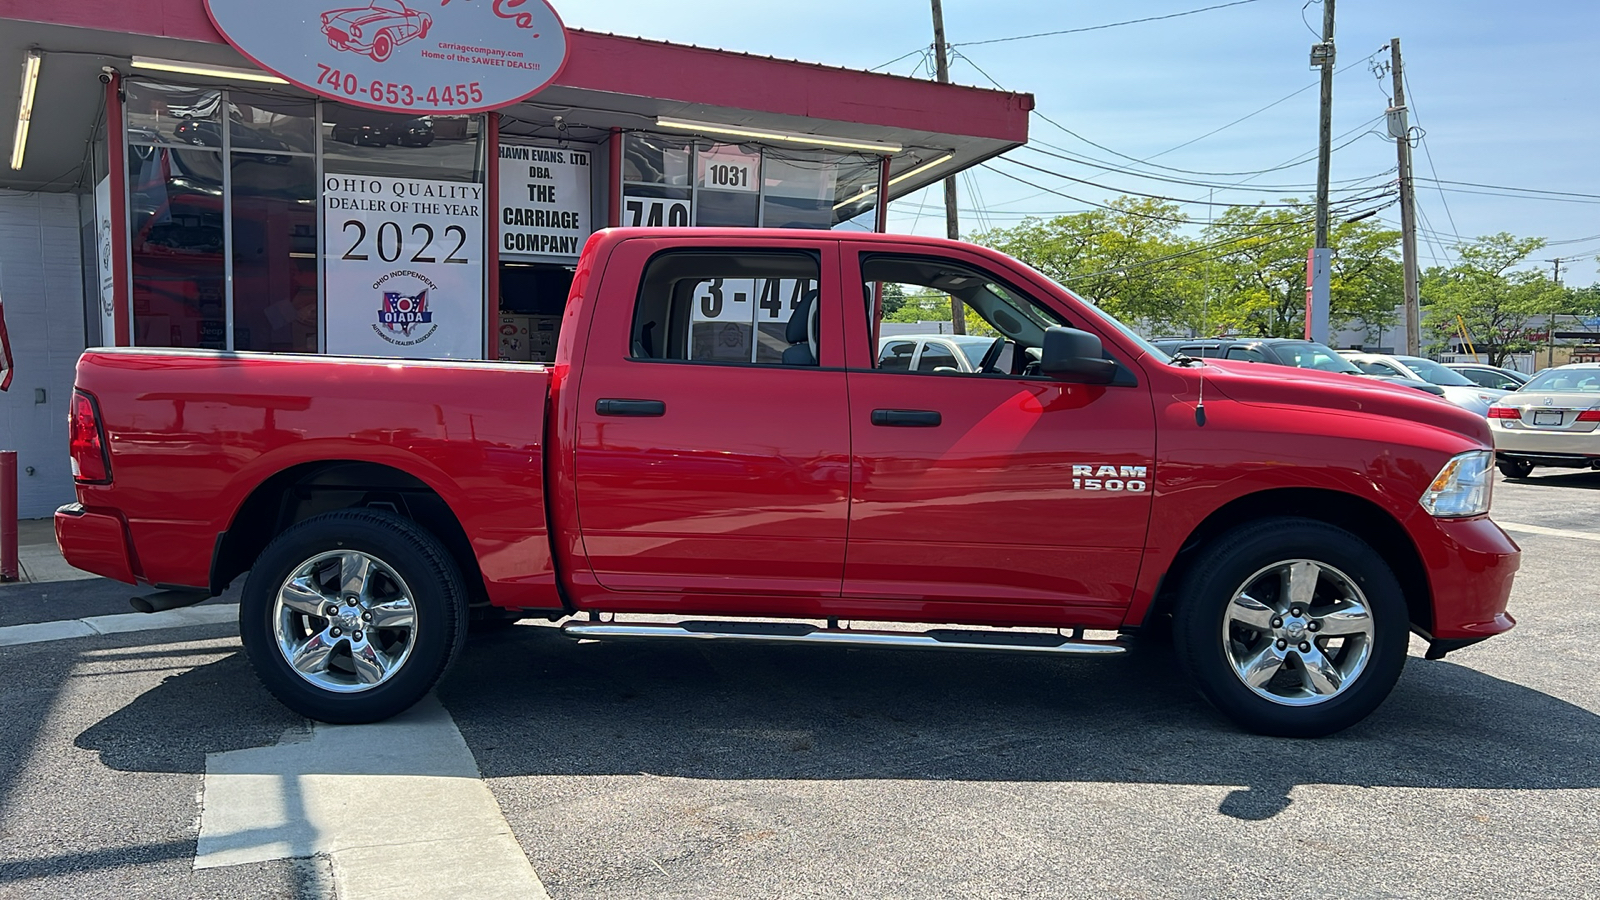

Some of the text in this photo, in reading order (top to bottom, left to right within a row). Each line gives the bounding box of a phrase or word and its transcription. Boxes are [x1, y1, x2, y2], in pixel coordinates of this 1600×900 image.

[438, 42, 524, 58] carriagecompany.com
[421, 50, 540, 71] Home of the SAWEET DEALS!!!
[316, 63, 483, 106] 740-653-4455
[531, 149, 566, 164] EVANS.
[570, 152, 589, 166] LTD.
[529, 166, 553, 179] DBA.
[710, 164, 748, 187] 1031
[327, 177, 482, 200] OHIO QUALITY
[527, 184, 556, 203] THE
[329, 197, 479, 217] DEALER OF THE YEAR
[503, 207, 579, 230] CARRIAGE
[341, 219, 469, 264] 2022
[504, 232, 579, 254] COMPANY
[372, 270, 438, 291] OHIO INDEPENDENT
[384, 312, 424, 323] OIADA
[1072, 464, 1147, 478] RAM
[1072, 478, 1146, 492] 1500
